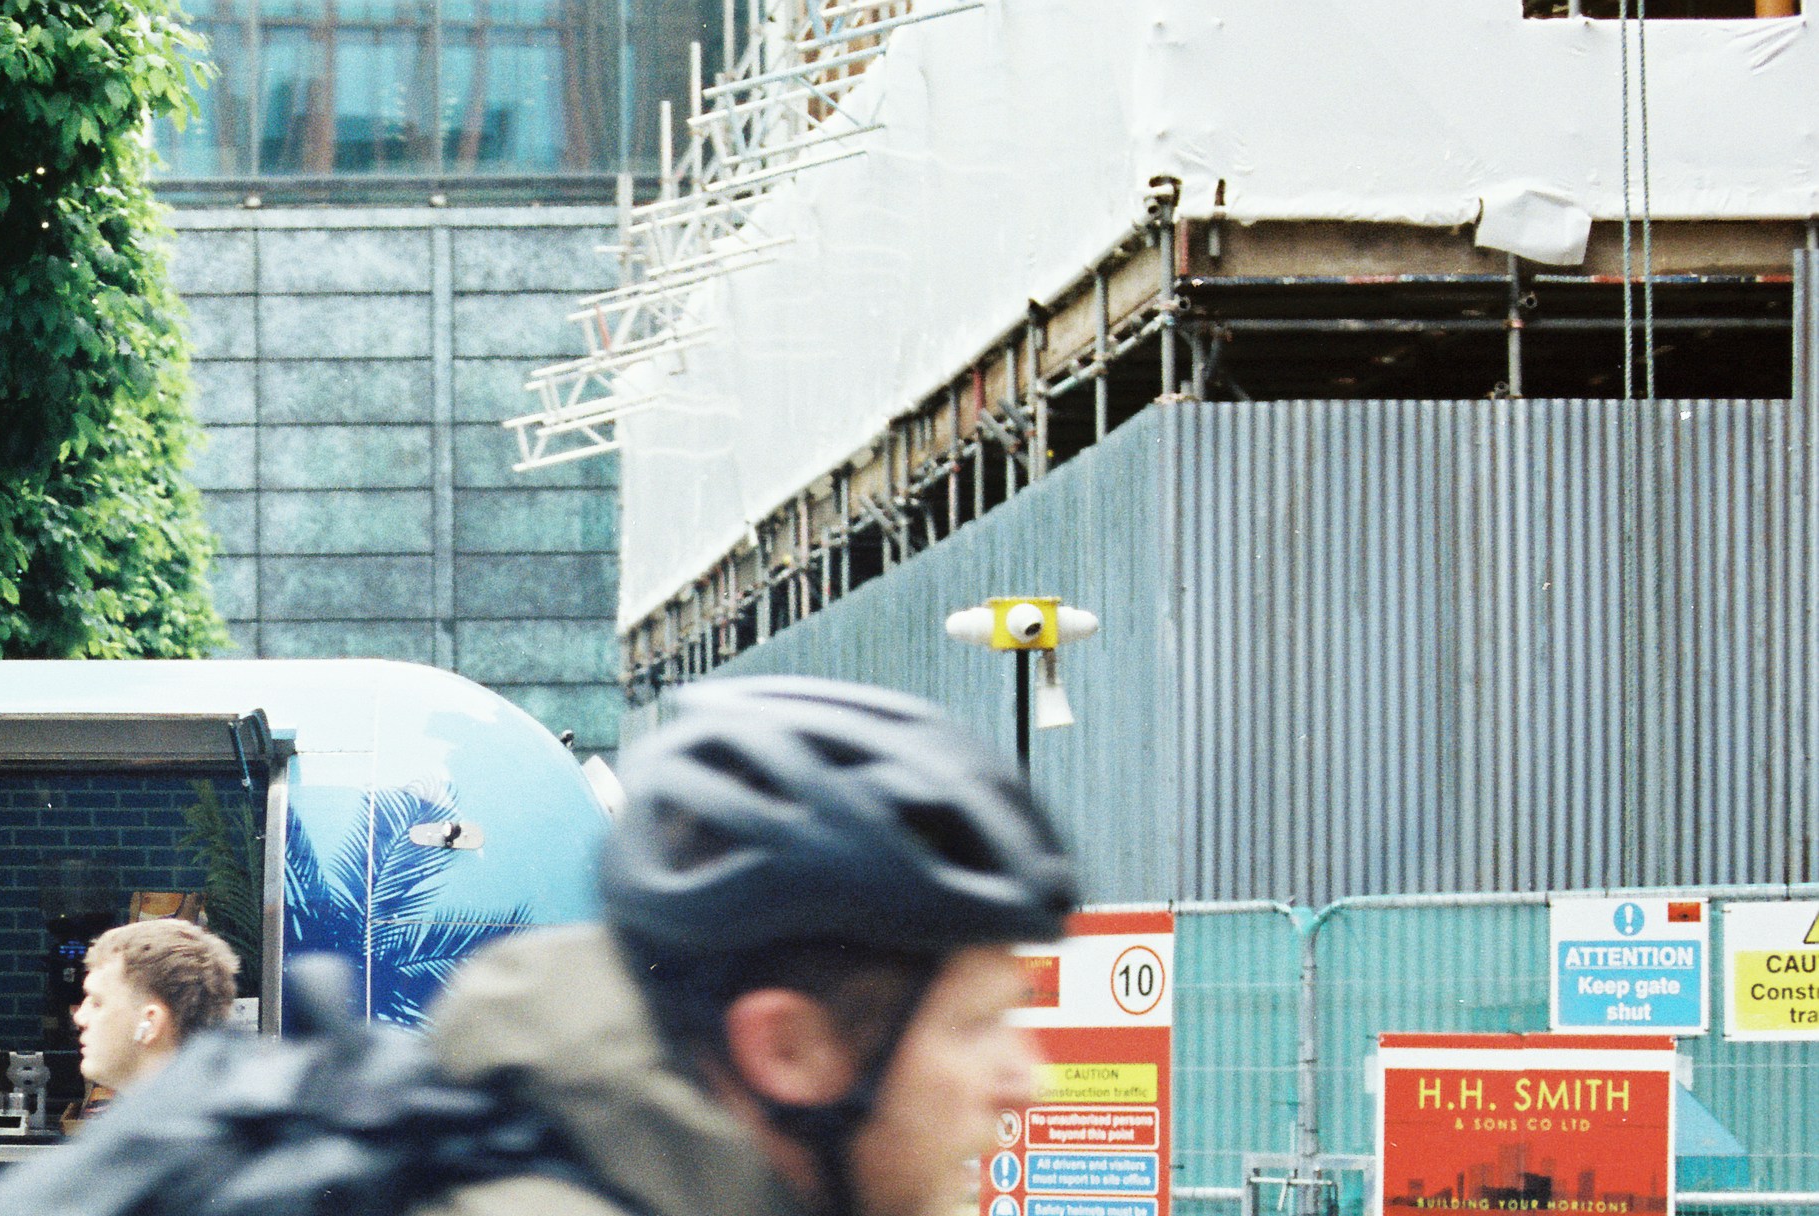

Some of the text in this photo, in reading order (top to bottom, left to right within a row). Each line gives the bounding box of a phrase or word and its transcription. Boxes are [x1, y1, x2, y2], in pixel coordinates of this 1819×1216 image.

[1565, 946, 1694, 967] ATTENTION
[1766, 954, 1819, 973] CAU
[1119, 964, 1154, 997] 10
[1577, 976, 1681, 999] Keep gate
[1607, 1002, 1652, 1021] shut
[1790, 1007, 1819, 1023] tra
[1065, 1069, 1119, 1080] CAUTION
[1113, 1086, 1149, 1098] traffic
[1419, 1077, 1630, 1112] H.H. SMITH
[1031, 1114, 1045, 1126] No
[1112, 1115, 1154, 1129] persons
[1455, 1118, 1591, 1132] & SONS CO LTD
[1049, 1128, 1134, 1142] beyond this point
[1037, 1159, 1146, 1171] All drivers and visitors
[1032, 1174, 1151, 1187] must report to site office
[1066, 1204, 1105, 1216] helmets
[1417, 1197, 1628, 1213] BUILDING YOUR HORIZONS
